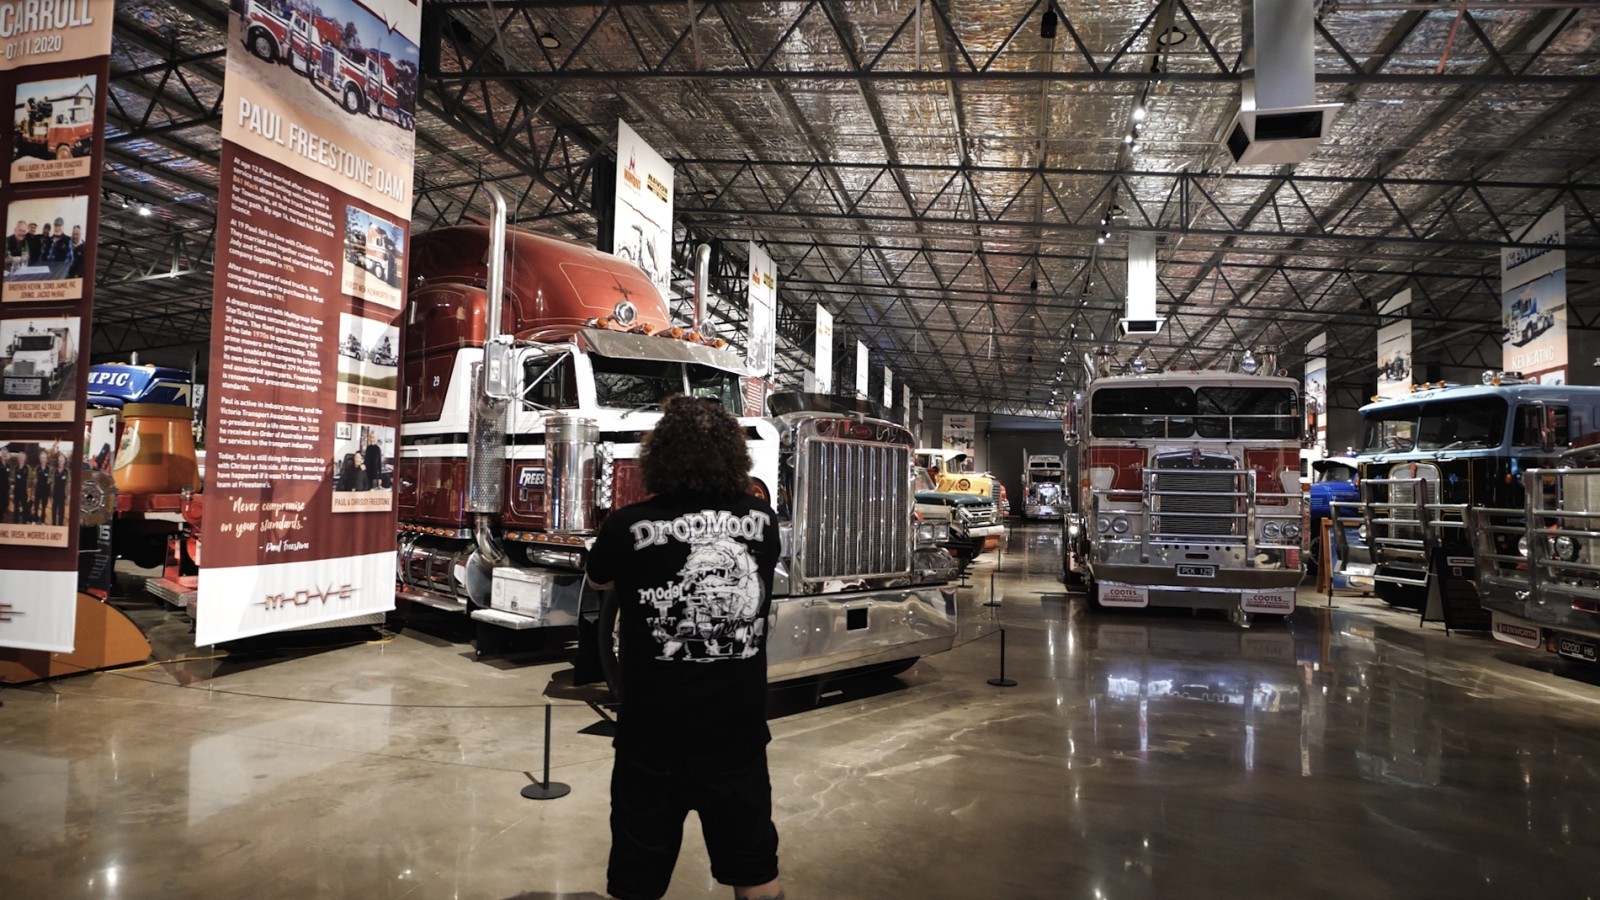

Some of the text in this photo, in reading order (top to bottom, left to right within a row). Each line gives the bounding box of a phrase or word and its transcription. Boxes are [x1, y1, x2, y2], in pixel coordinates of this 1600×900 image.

[0, 0, 93, 37] CARROLL
[6, 35, 61, 59] 07.11.2020
[238, 97, 405, 201] PAUL FREESTONE OAM
[234, 365, 263, 375] associated
[265, 370, 278, 378] spare
[294, 374, 322, 383] Freestone's
[228, 373, 295, 390] renowned presentation
[240, 399, 303, 412] active industry matters
[220, 407, 241, 416] Victoria
[242, 409, 269, 420] Transport
[220, 419, 255, 429] ex-president
[227, 428, 250, 436] received
[281, 431, 302, 439] Australia
[228, 437, 251, 445] services
[269, 440, 290, 449] transport
[268, 455, 281, 463] doing
[231, 463, 251, 471] Chrissy
[231, 472, 258, 480] happened
[302, 473, 321, 481] amazing
[262, 501, 305, 517] compromise
[220, 523, 232, 532] on
[236, 522, 257, 538] your
[1502, 625, 1536, 639] KENWORTH
